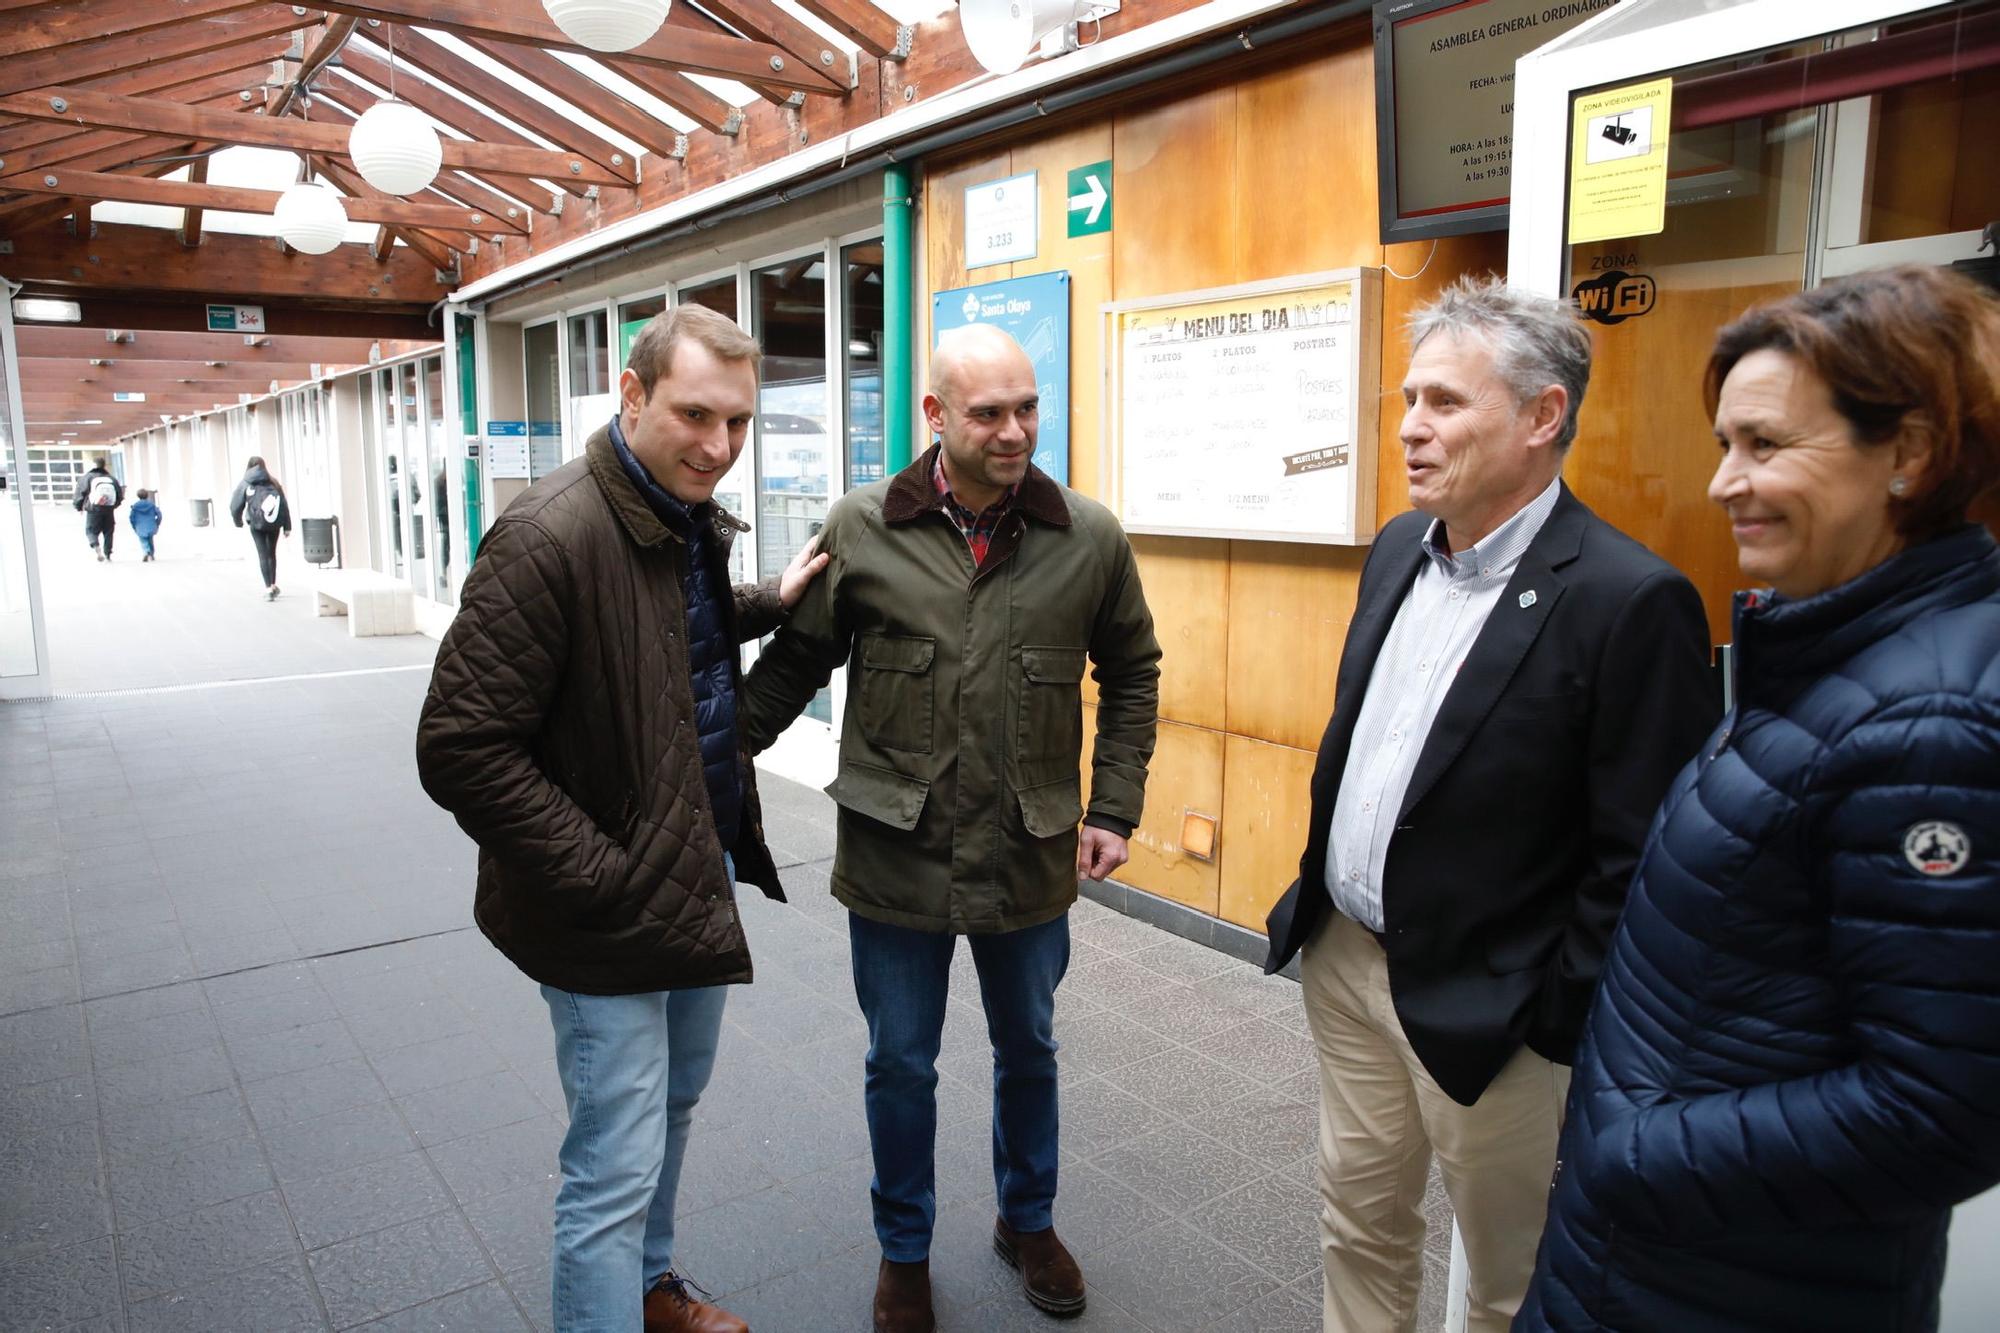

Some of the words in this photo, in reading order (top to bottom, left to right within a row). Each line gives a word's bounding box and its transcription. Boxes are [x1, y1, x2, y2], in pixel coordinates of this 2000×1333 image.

[1429, 28, 1486, 53] ASAMBLEA
[1489, 15, 1538, 37] GENERAL
[1469, 76, 1498, 90] FECHA:
[1583, 102, 1602, 112] ZONA
[1605, 89, 1661, 107] VIDEOVIGILADA
[1450, 142, 1475, 154] HORA:
[1477, 141, 1483, 149] A
[1485, 139, 1496, 148] las
[1463, 158, 1469, 167] A
[1471, 157, 1482, 166] las
[1484, 151, 1507, 163] 19:15
[1466, 174, 1471, 182] A
[1473, 171, 1484, 181] las
[1487, 166, 1509, 178] 19:30
[987, 232, 1012, 249] 3.233
[1591, 253, 1638, 270] ZONA
[982, 303, 1005, 317] Santa
[1007, 298, 1031, 316] Olaya
[1184, 316, 1225, 340] MENU
[1229, 313, 1257, 334] DEL
[1262, 307, 1289, 331] DIA
[1223, 346, 1257, 357] PLATOS
[1292, 337, 1336, 351] POSTRES
[1151, 352, 1182, 363] PLATOS
[1242, 495, 1270, 504] MENU
